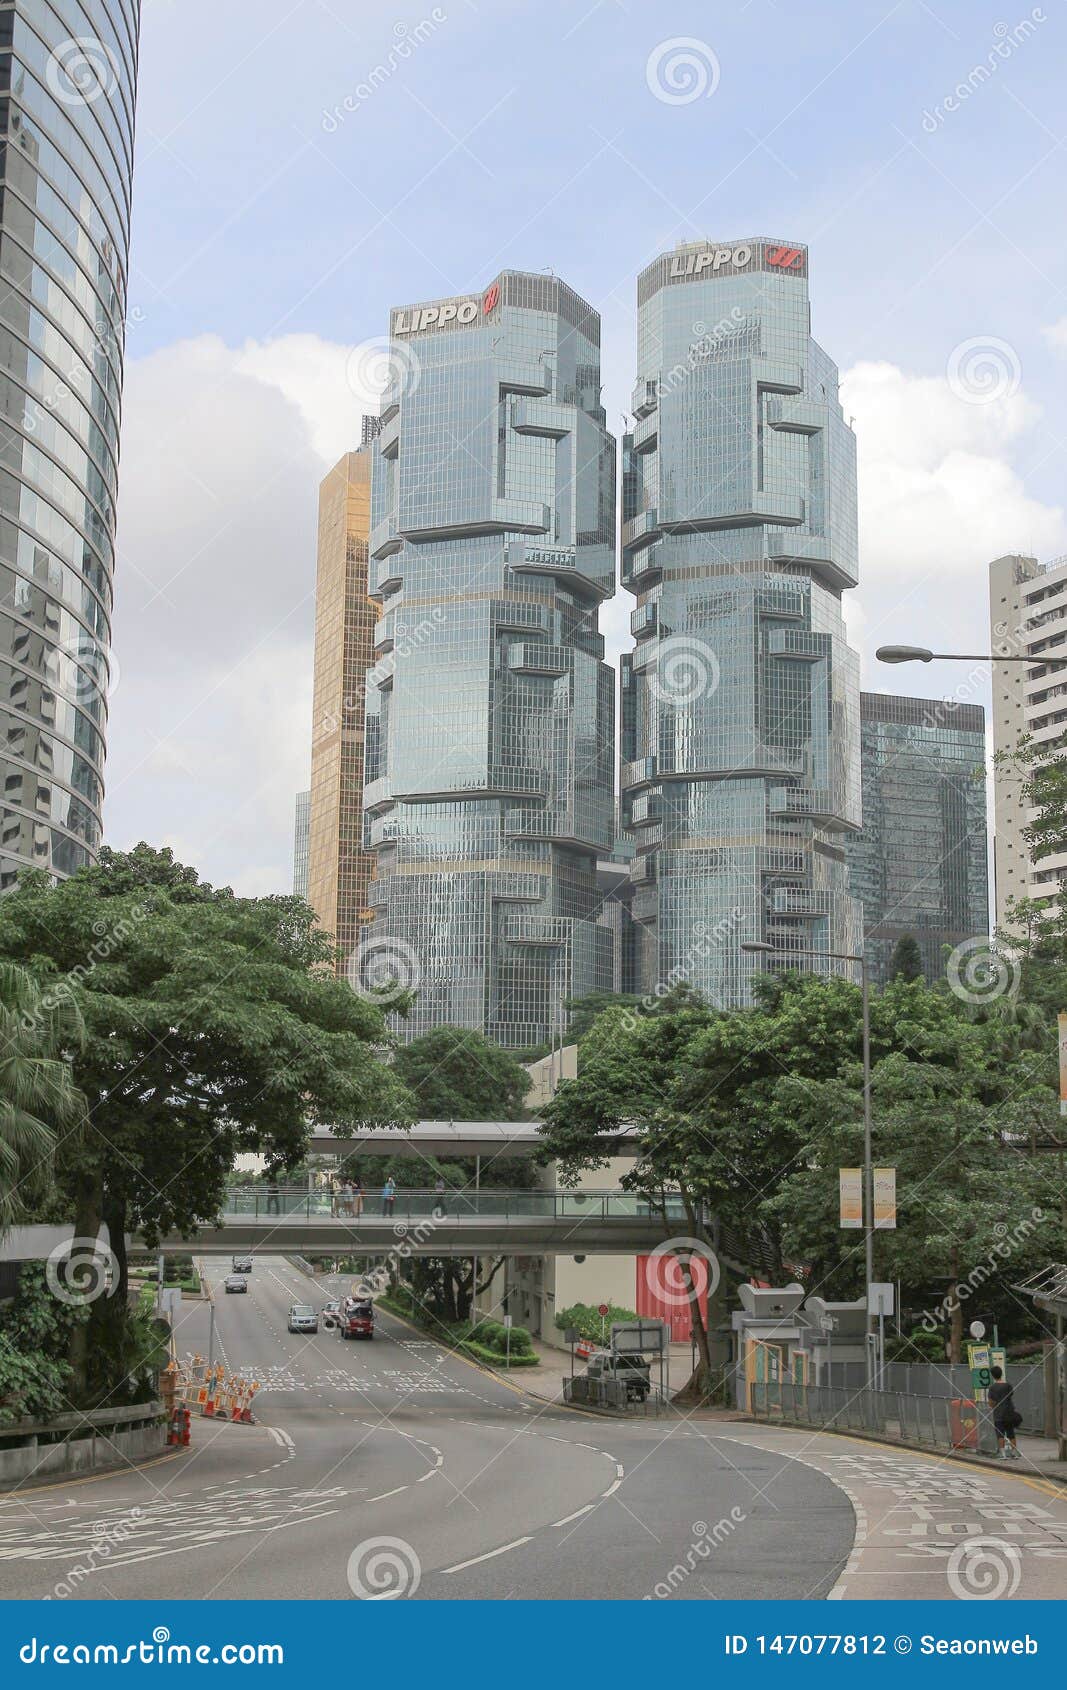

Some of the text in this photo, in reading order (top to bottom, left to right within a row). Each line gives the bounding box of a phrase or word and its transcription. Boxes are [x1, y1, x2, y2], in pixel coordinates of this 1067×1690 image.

[669, 245, 752, 278] LIPPO
[395, 301, 478, 335] LIPPO
[979, 1367, 991, 1387] 9
